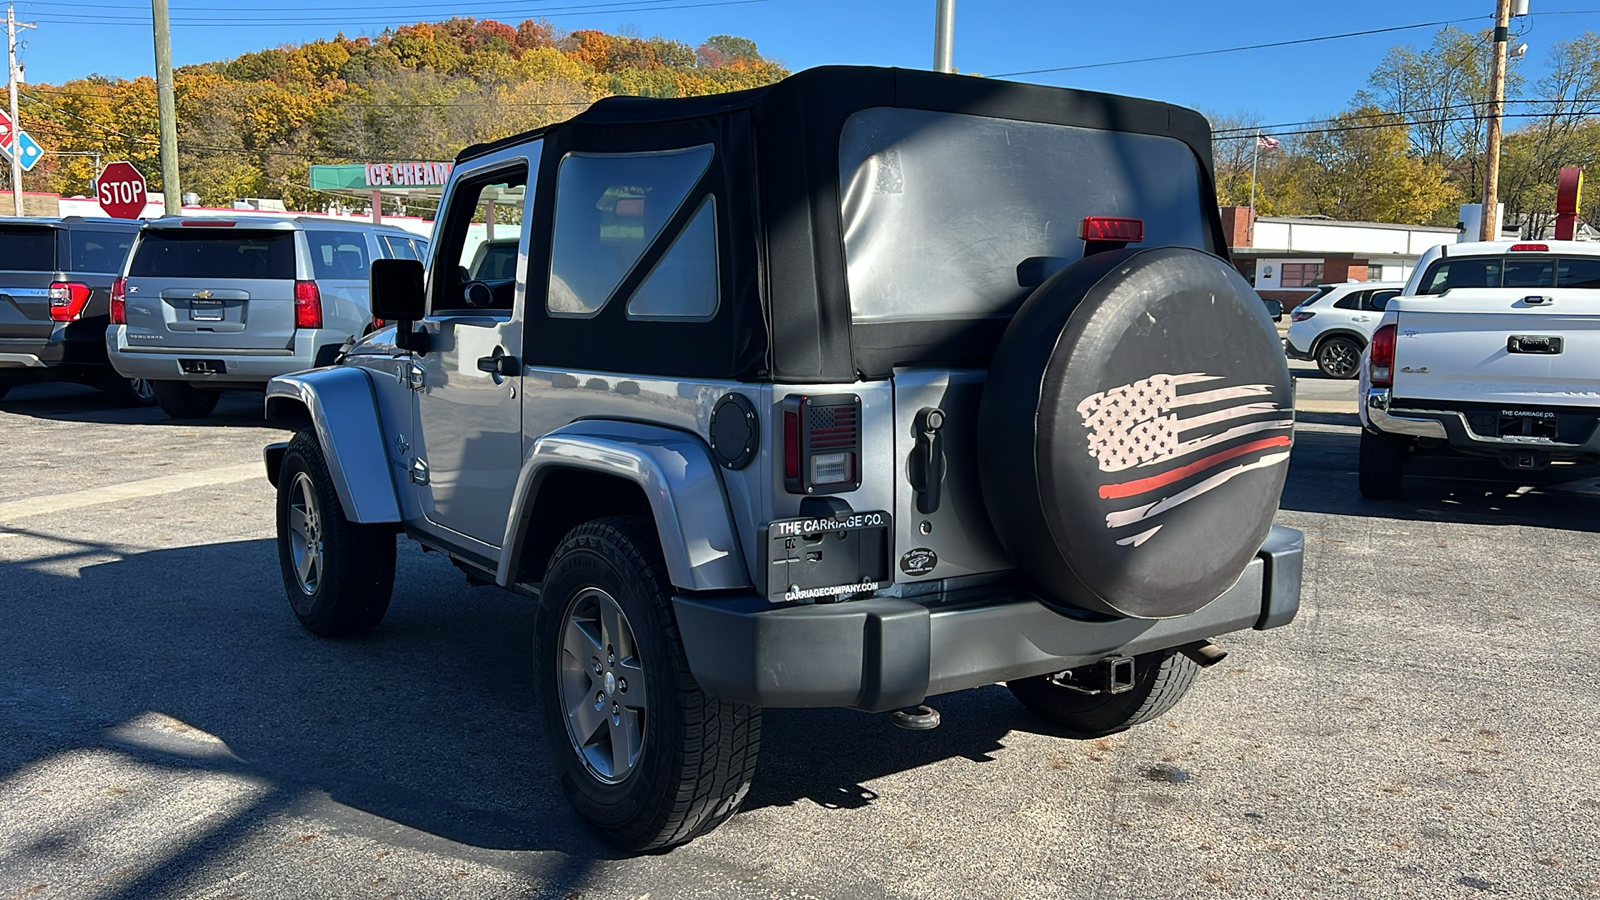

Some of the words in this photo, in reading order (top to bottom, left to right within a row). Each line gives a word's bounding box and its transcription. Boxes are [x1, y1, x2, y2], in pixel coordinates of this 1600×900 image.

[365, 164, 392, 186] ICE
[392, 162, 451, 185] CREAM
[100, 180, 143, 205] STOP
[1513, 410, 1543, 418] CARRIAGE
[778, 521, 802, 535] THE
[803, 515, 862, 532] CARRIAGE
[864, 513, 885, 526] CO.
[785, 582, 879, 602] CARRIAGECOMPANY.COM
